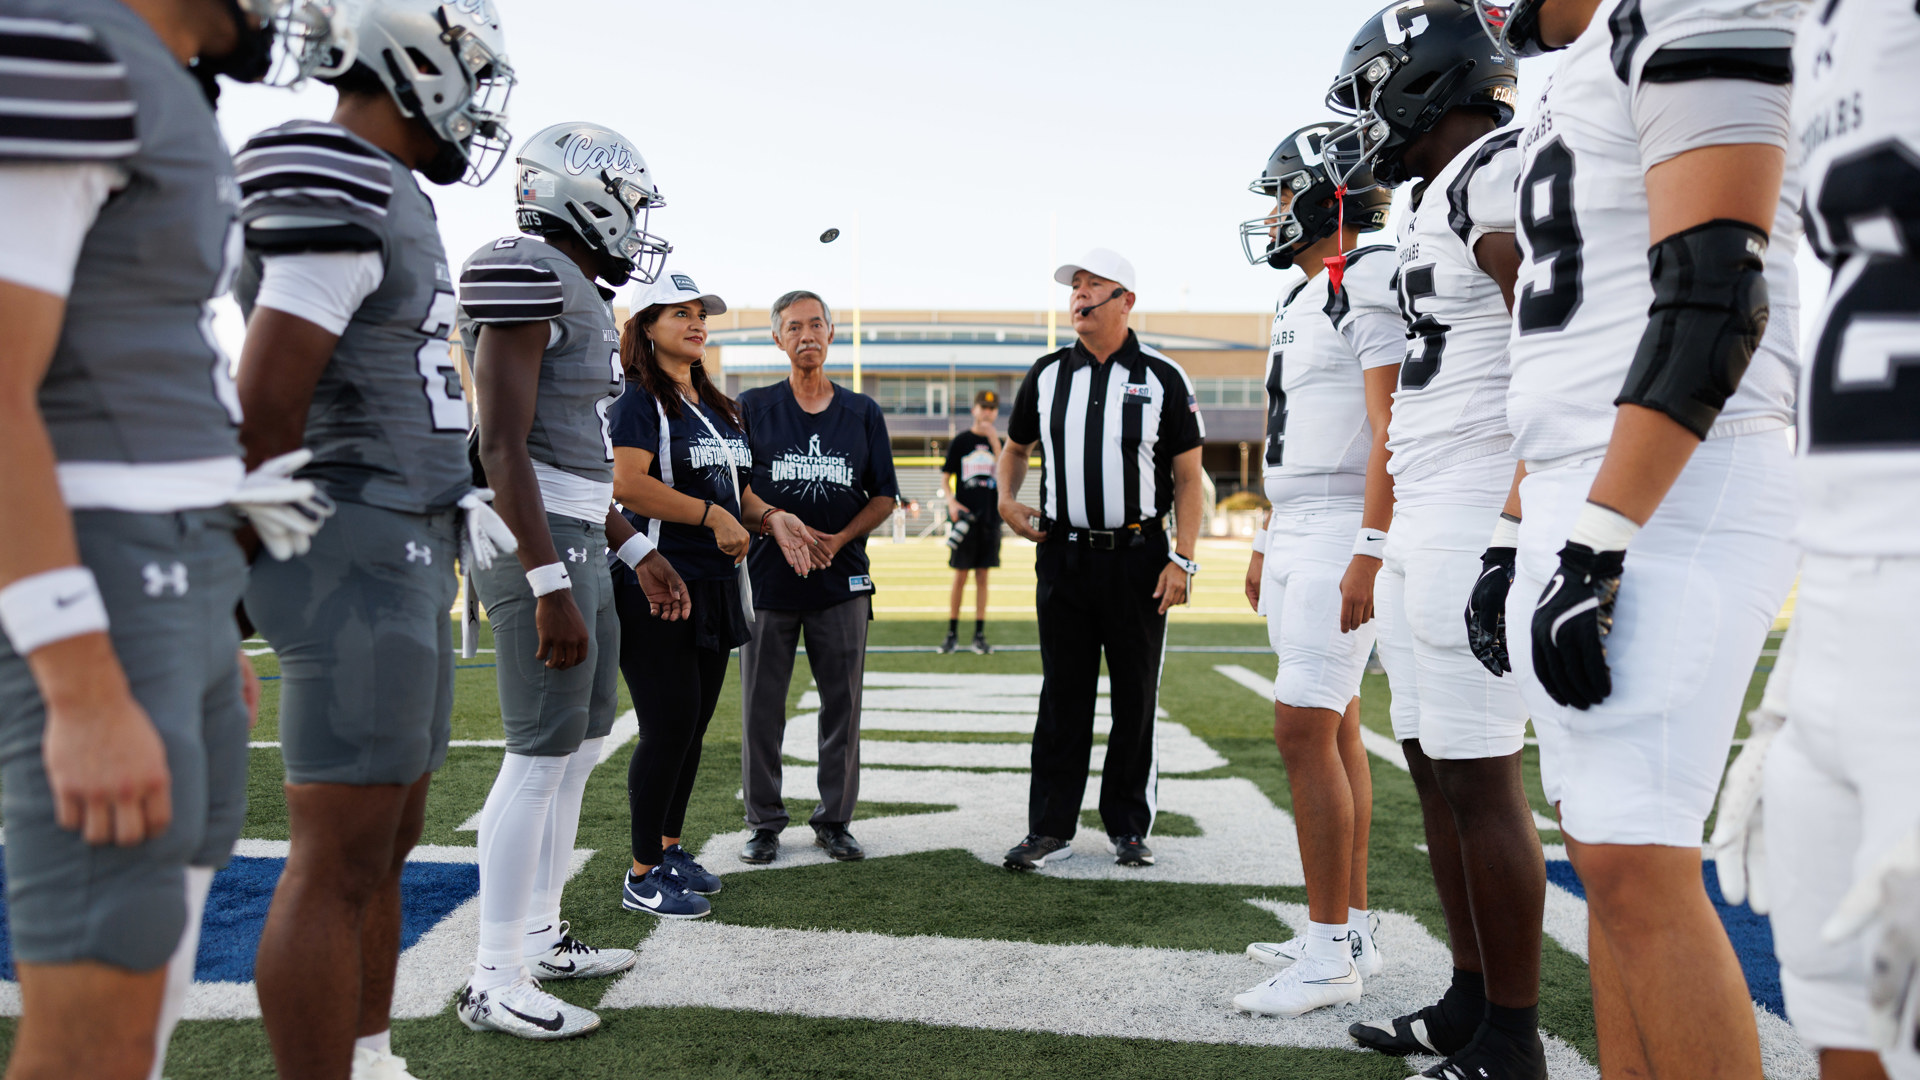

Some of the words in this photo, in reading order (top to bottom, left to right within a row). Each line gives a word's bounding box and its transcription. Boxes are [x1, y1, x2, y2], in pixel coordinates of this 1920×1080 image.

[564, 134, 638, 175] Cats
[783, 453, 846, 466] NORTHSIDE
[772, 460, 854, 487] UNSTOPPABLE
